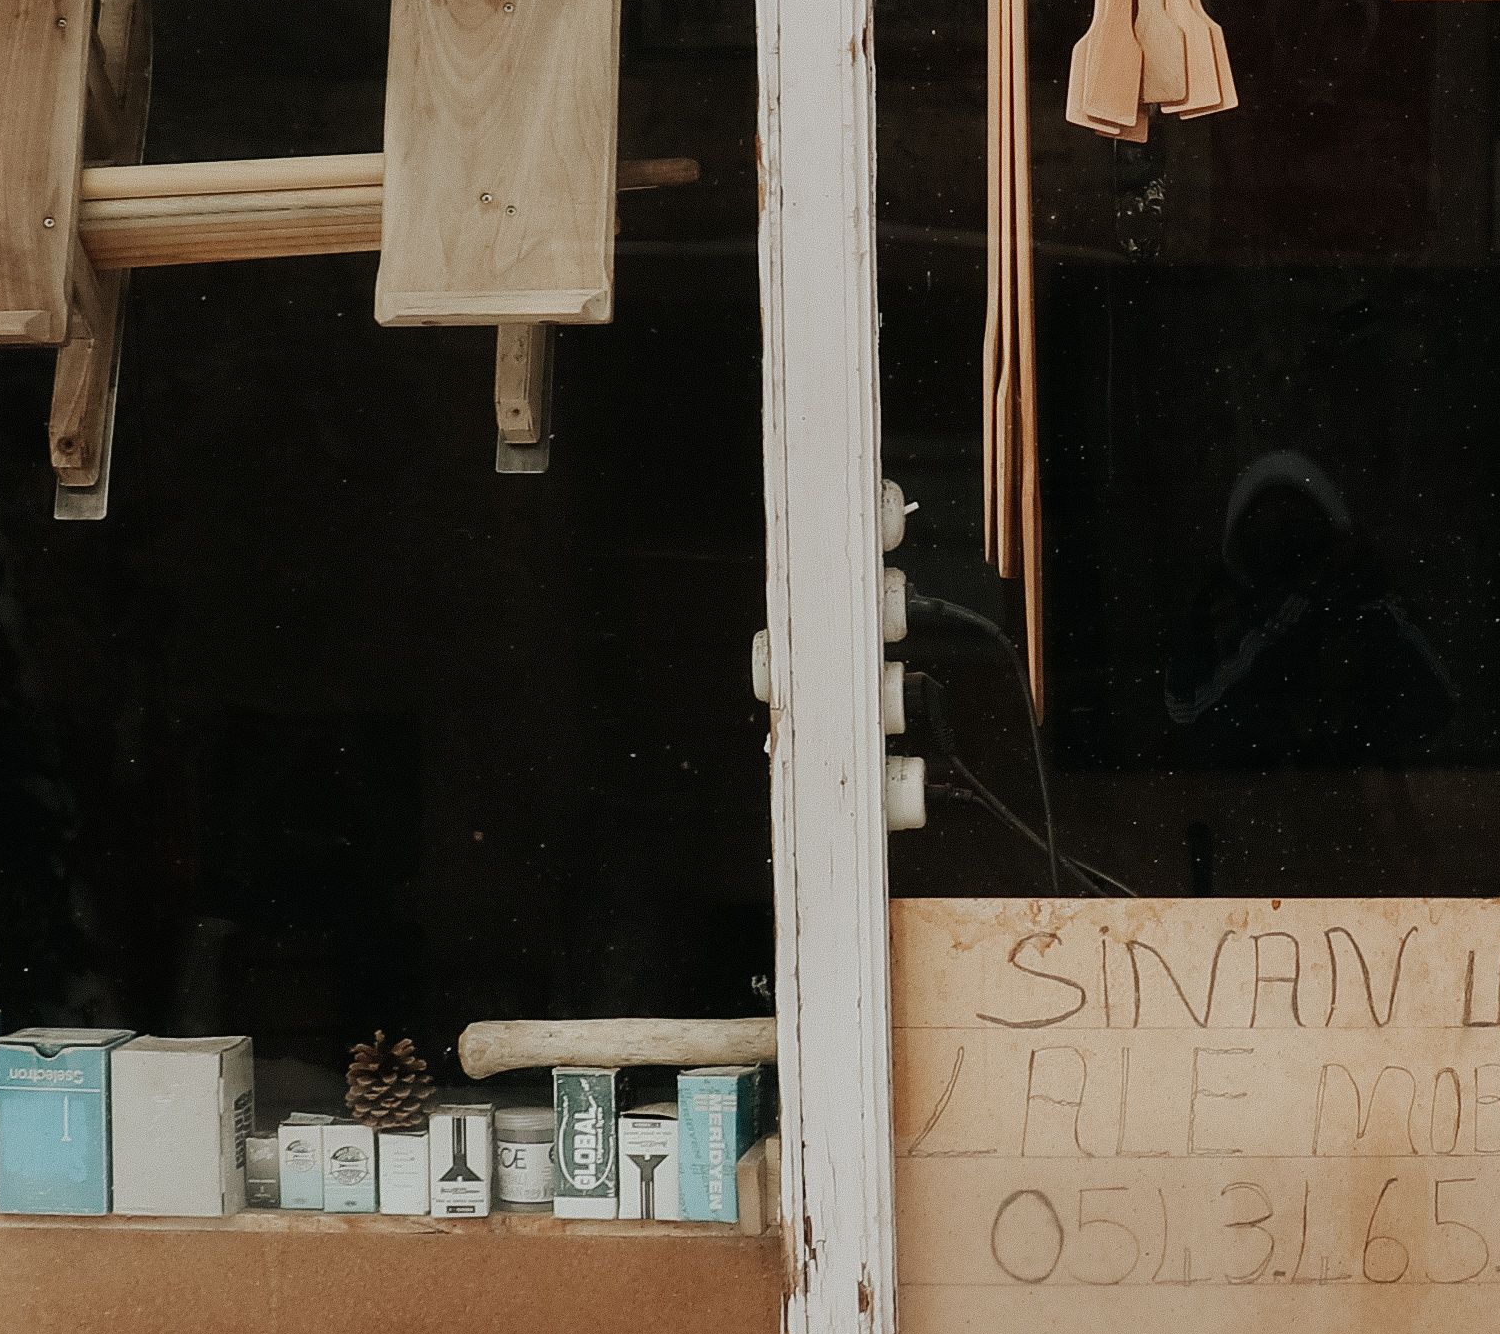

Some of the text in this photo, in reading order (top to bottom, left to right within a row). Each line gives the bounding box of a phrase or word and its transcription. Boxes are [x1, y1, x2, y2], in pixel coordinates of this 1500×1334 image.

[975, 925, 1419, 1029] SİNAN
[573, 1108, 597, 1190] GLOBAL
[906, 1045, 1256, 1157] LALE
